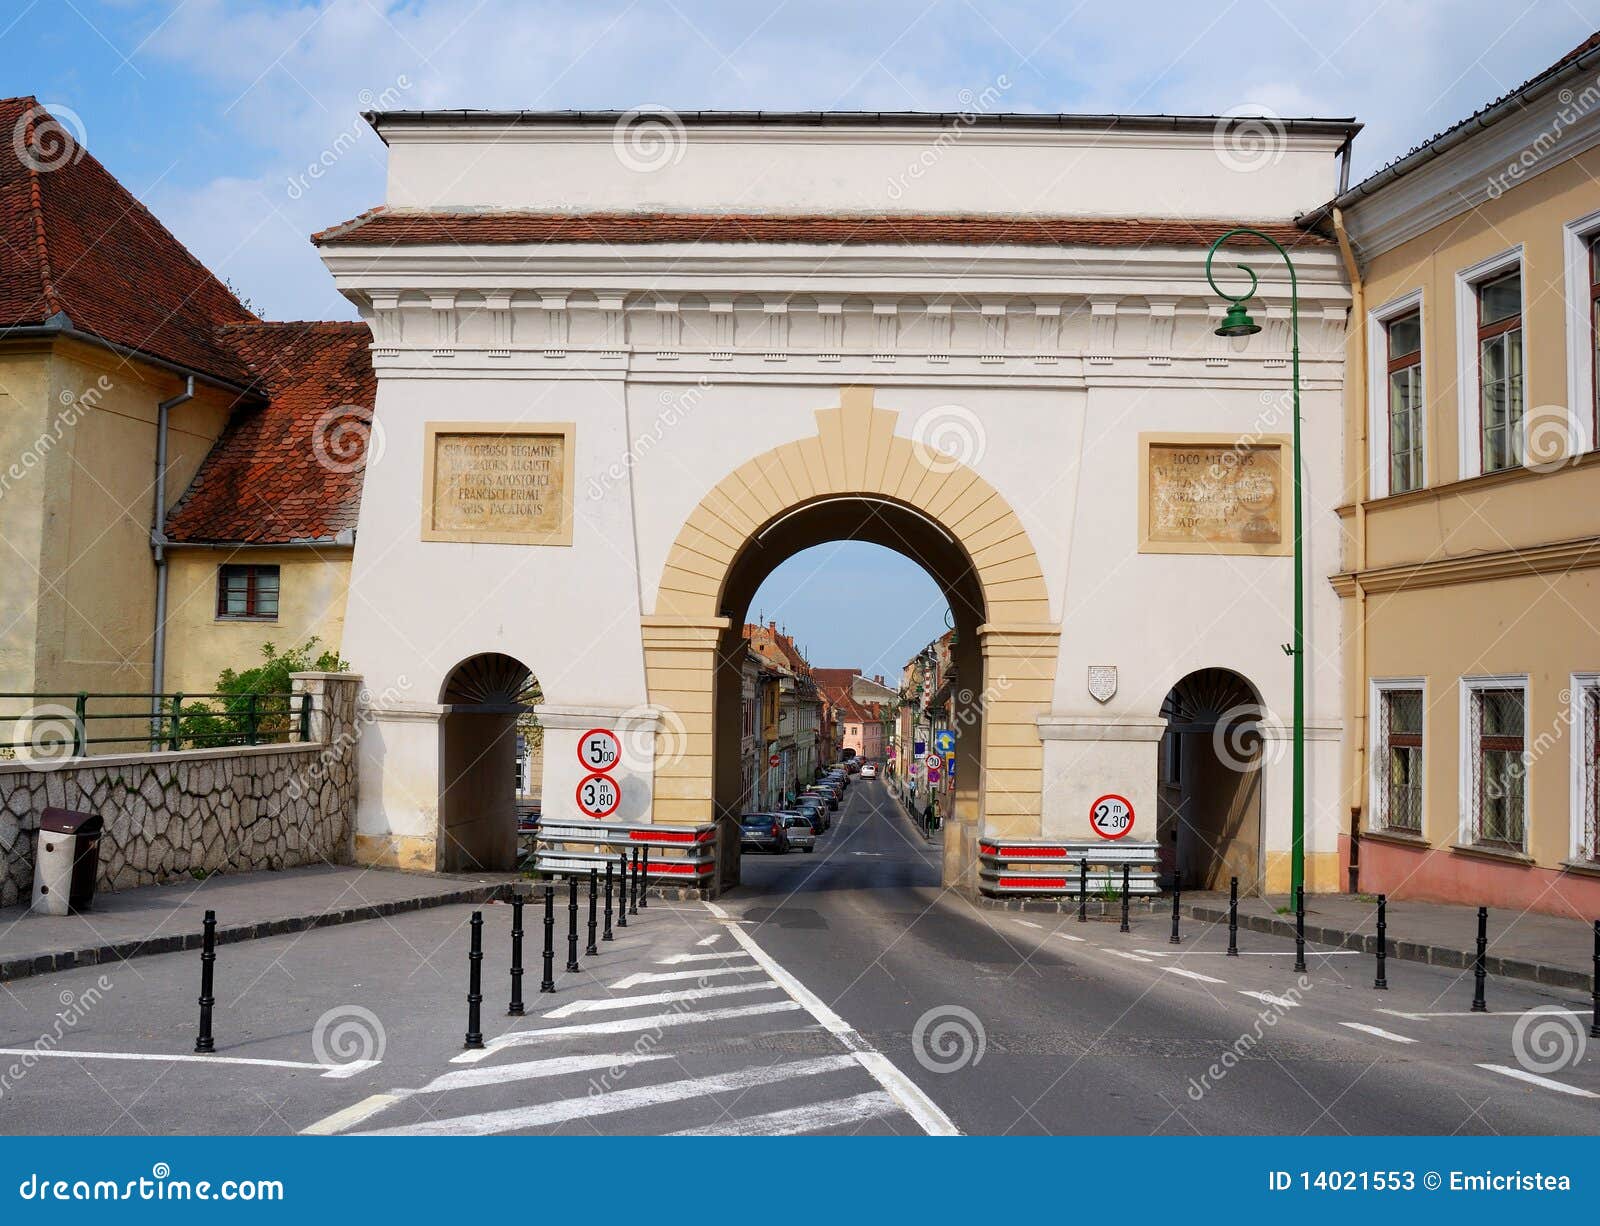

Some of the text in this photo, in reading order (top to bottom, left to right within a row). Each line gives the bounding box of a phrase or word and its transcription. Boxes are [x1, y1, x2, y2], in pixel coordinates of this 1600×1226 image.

[511, 445, 556, 457] REGIMINE
[496, 474, 550, 487] APOSTOLICI
[458, 488, 539, 500] FRANCISCI PRIMI
